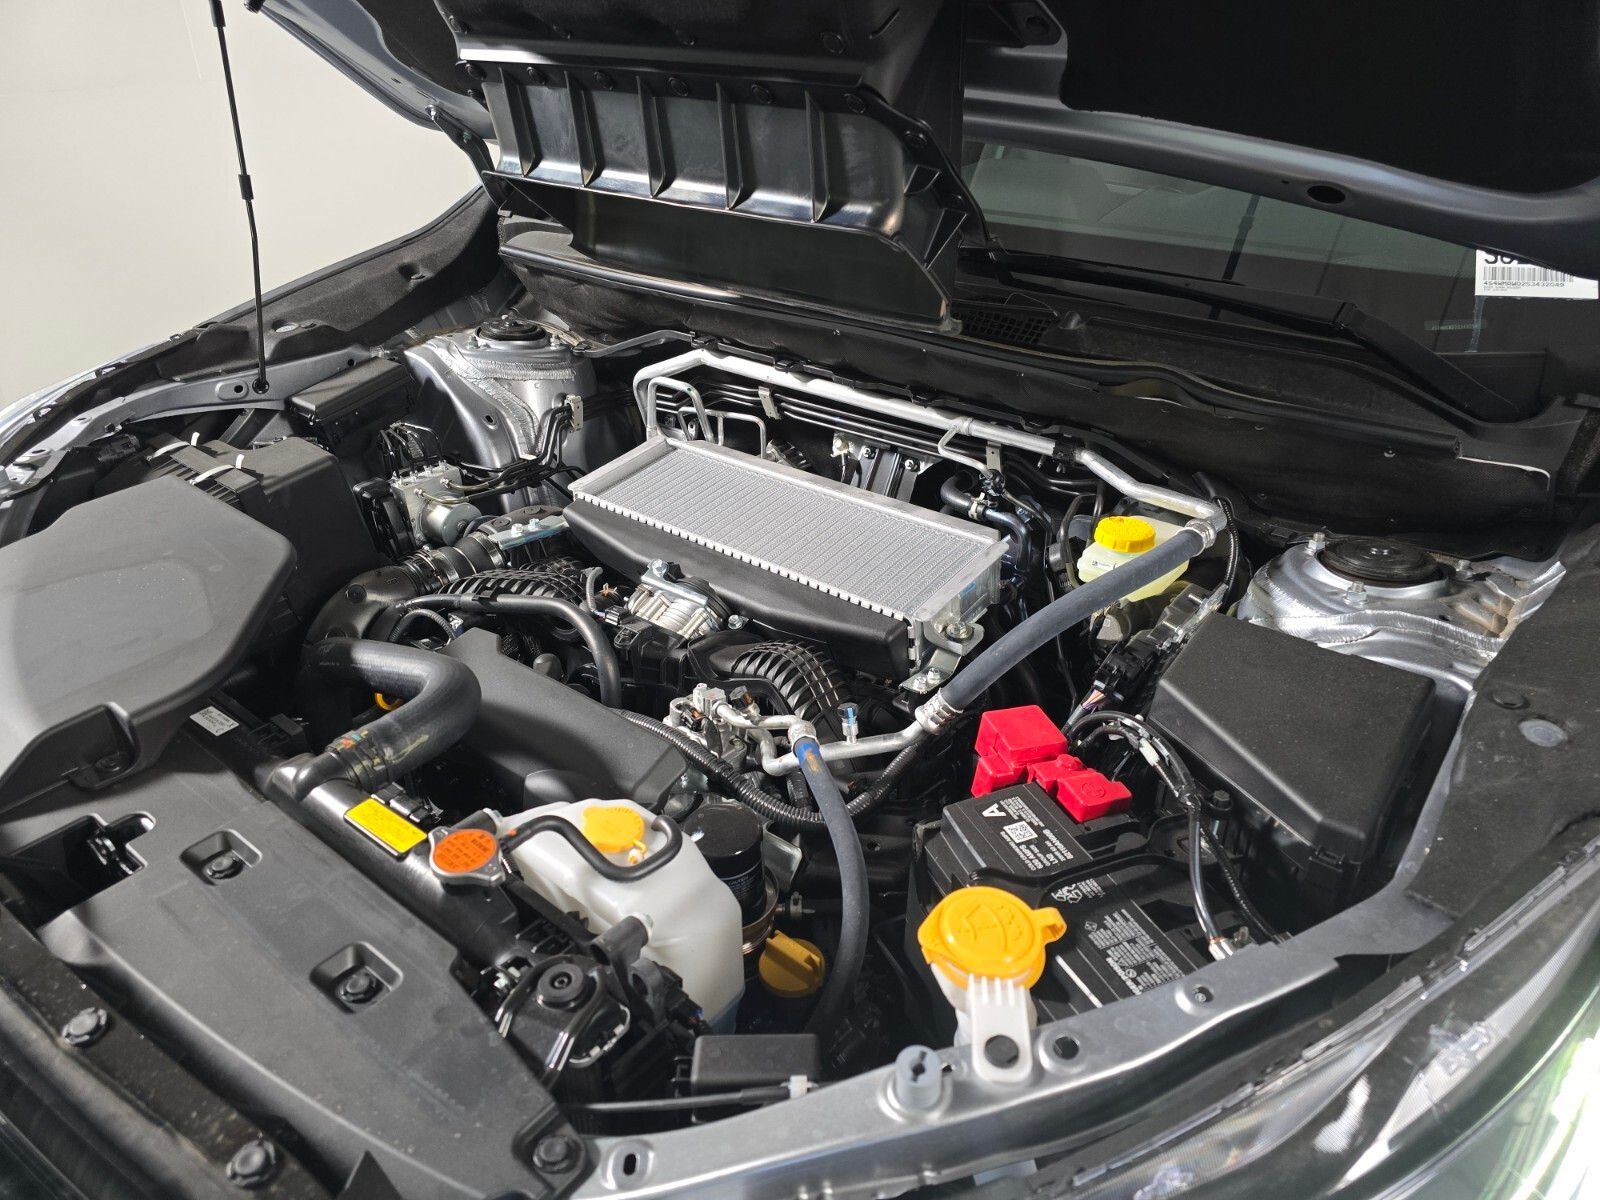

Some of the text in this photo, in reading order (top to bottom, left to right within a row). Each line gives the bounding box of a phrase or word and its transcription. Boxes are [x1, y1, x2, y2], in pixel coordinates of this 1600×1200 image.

[982, 803, 1007, 817] A
[1000, 831, 1037, 871] COLD CRANKING AMPS
[1019, 844, 1035, 860] AMPS
[1029, 844, 1051, 866] GROUP SIZE
